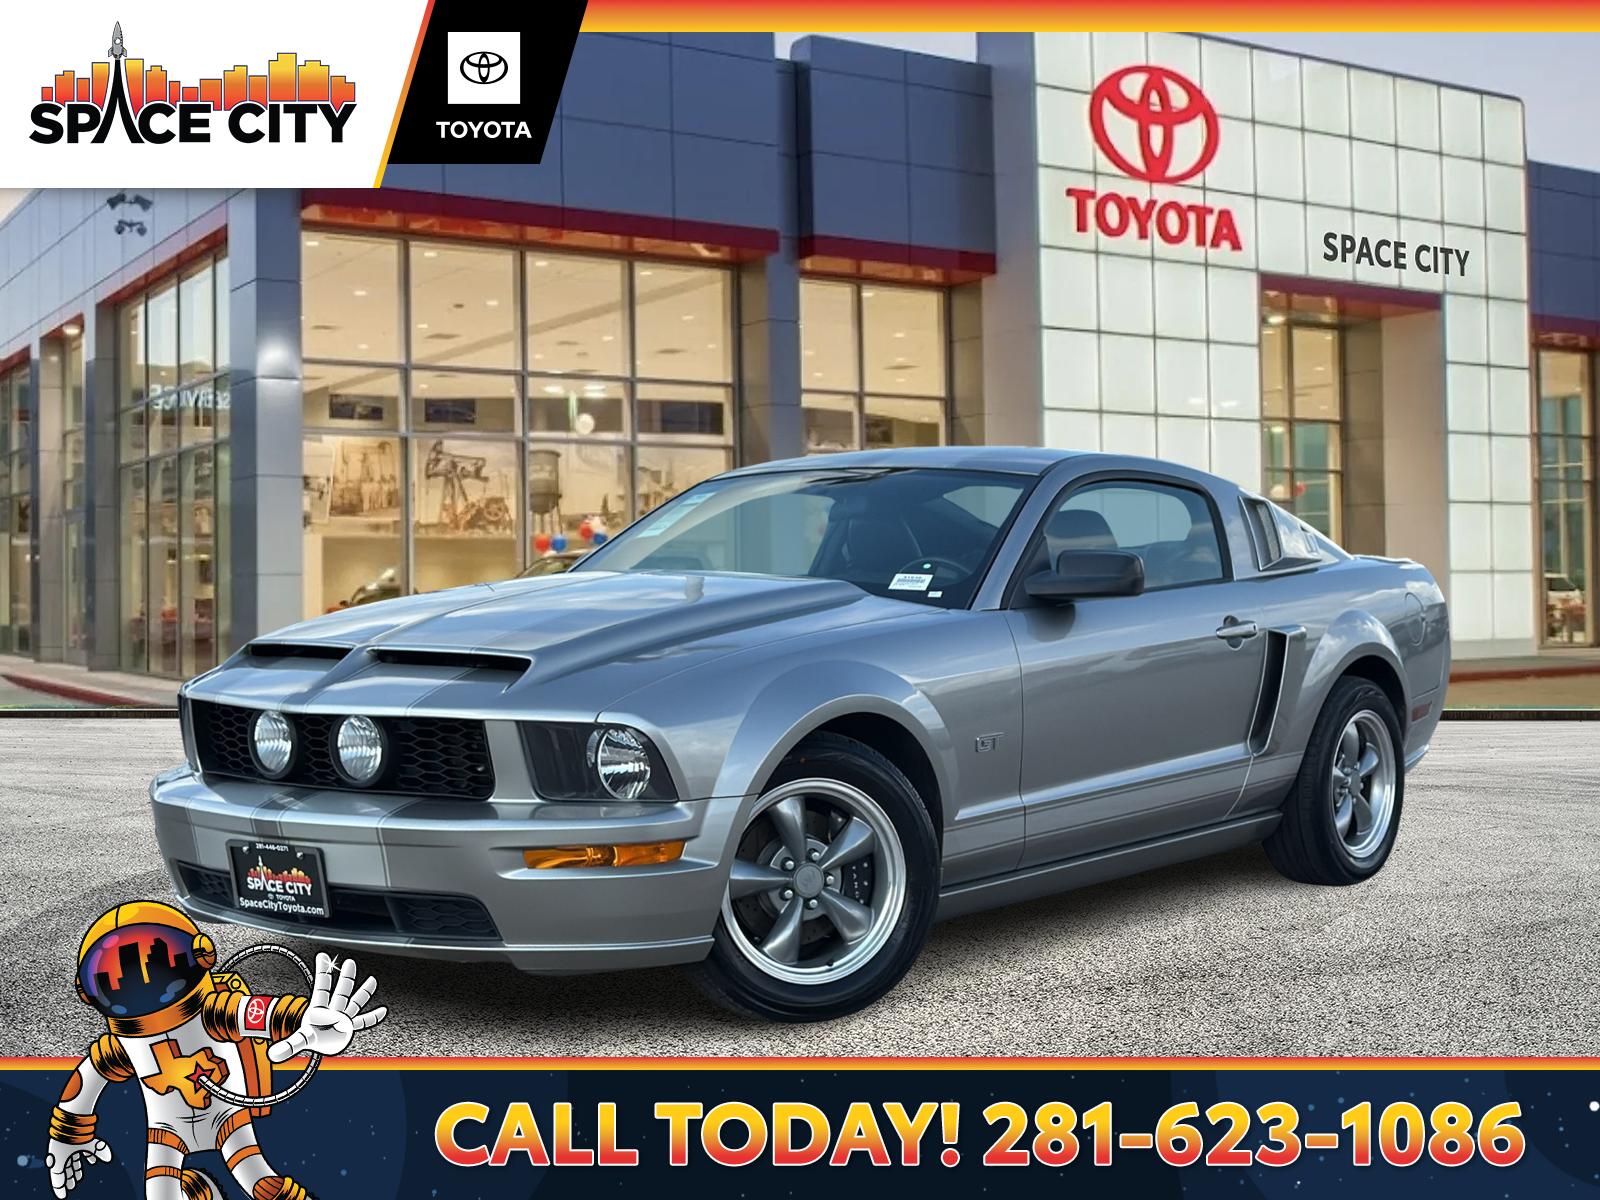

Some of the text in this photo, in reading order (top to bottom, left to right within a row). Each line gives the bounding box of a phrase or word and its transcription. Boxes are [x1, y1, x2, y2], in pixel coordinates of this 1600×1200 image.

[1066, 188, 1243, 252] TOYOTA
[1323, 232, 1470, 277] SPACE CITY
[975, 731, 1005, 753] GT
[246, 873, 312, 896] SPACE CITY
[239, 896, 325, 915] SpaceCityToyota.com
[275, 894, 296, 902] TOYOTA
